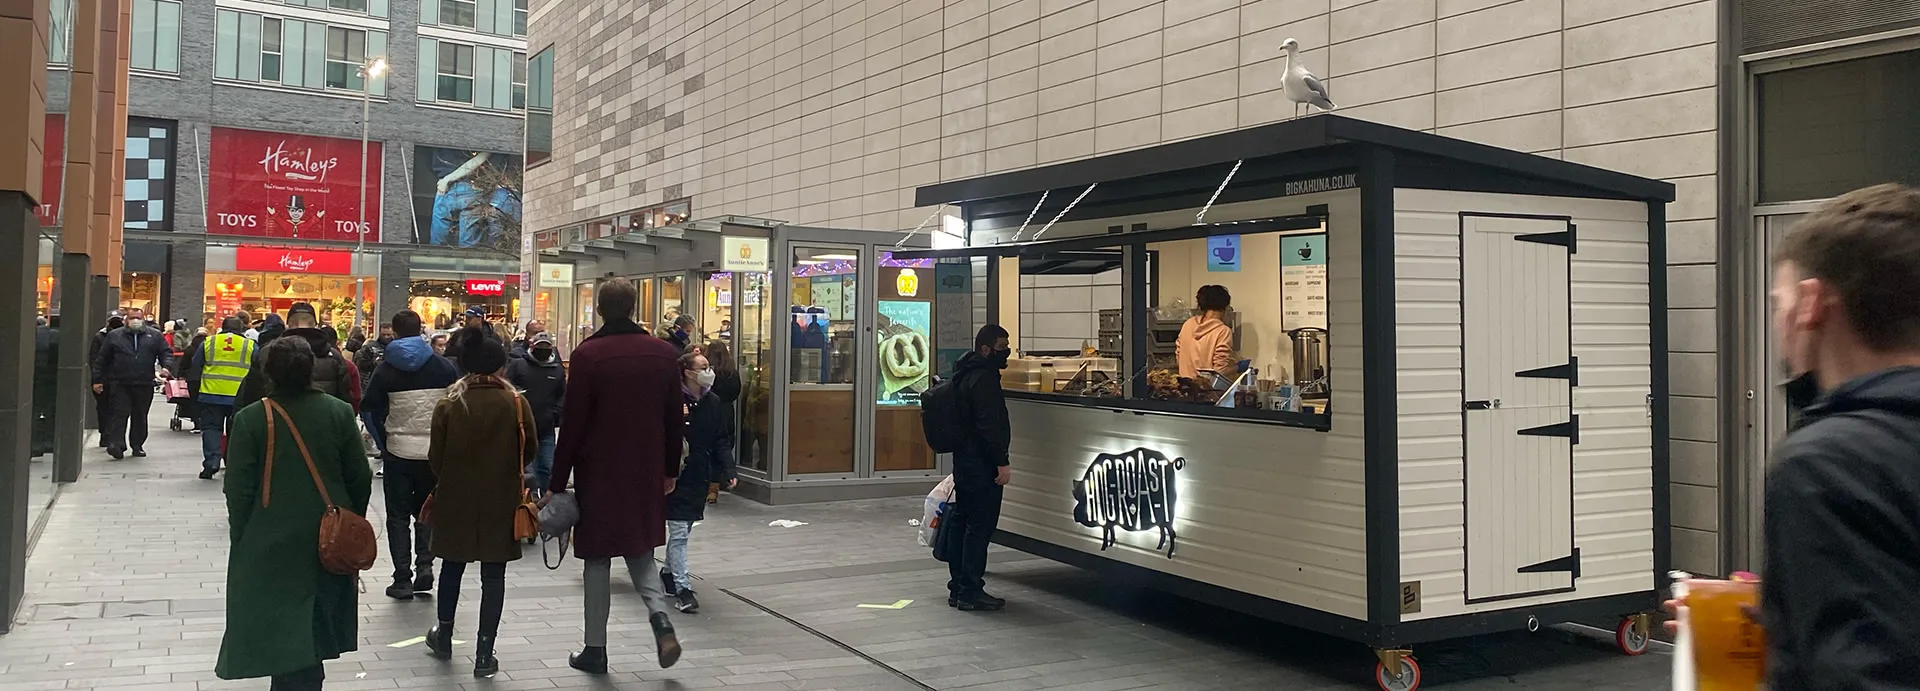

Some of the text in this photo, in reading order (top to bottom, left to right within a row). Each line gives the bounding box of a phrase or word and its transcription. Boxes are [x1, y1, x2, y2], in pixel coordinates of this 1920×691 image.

[258, 139, 337, 183] Hamleys
[1285, 173, 1356, 196] BIGKAHUNA.CO.UK
[217, 213, 257, 228] TOYS
[335, 220, 371, 235] TOYS
[278, 252, 314, 271] Hamleys
[1084, 450, 1169, 531] HOG ROAST
